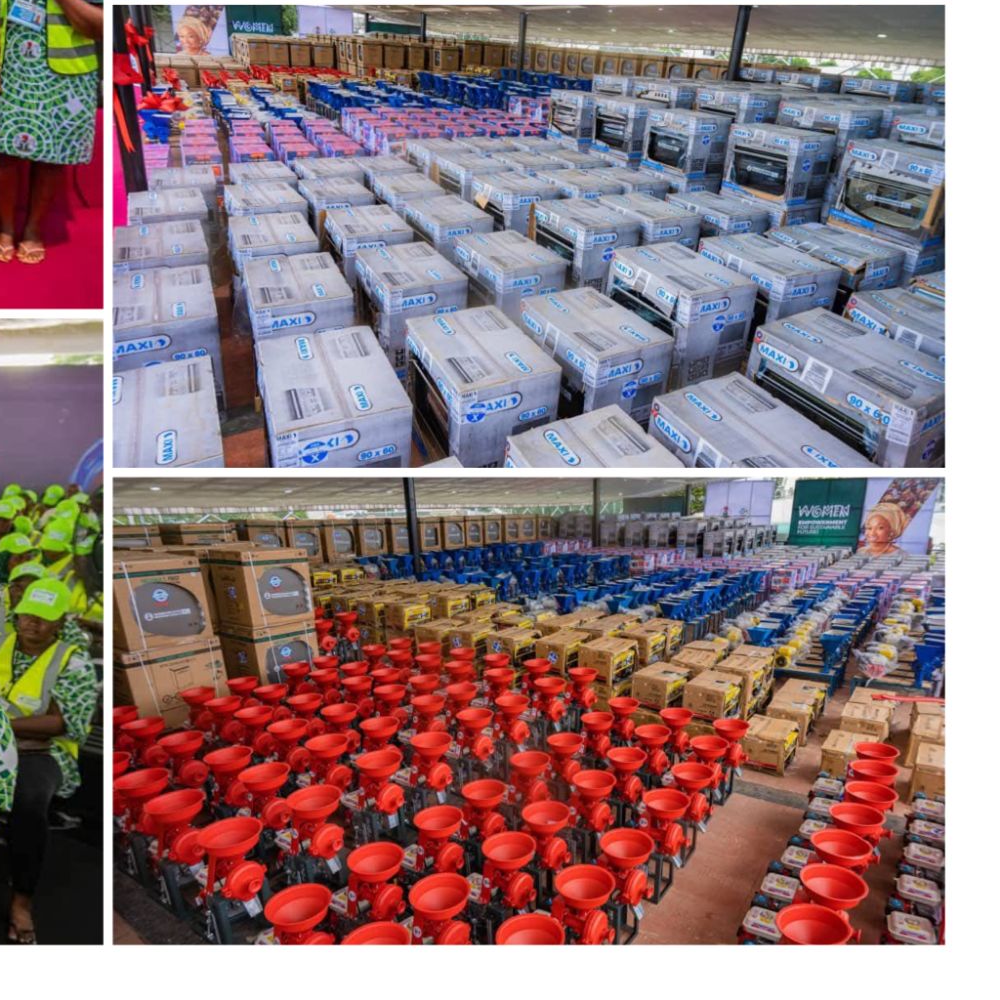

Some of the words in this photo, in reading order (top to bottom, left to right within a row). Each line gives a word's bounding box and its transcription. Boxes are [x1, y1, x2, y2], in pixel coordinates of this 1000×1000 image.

[232, 20, 274, 33] WOMEN
[850, 310, 876, 330] MAXI
[760, 345, 787, 364] MAXI
[486, 398, 507, 411] AXI
[687, 394, 711, 414] MAXI
[850, 395, 863, 408] 90
[863, 406, 870, 414] x
[872, 409, 891, 425] 60
[656, 418, 680, 443] MAXI
[162, 438, 174, 463] MAXI
[360, 451, 373, 460] 90
[382, 446, 394, 455] 60
[547, 432, 570, 457] MAXI
[798, 504, 850, 518] WOMEN
